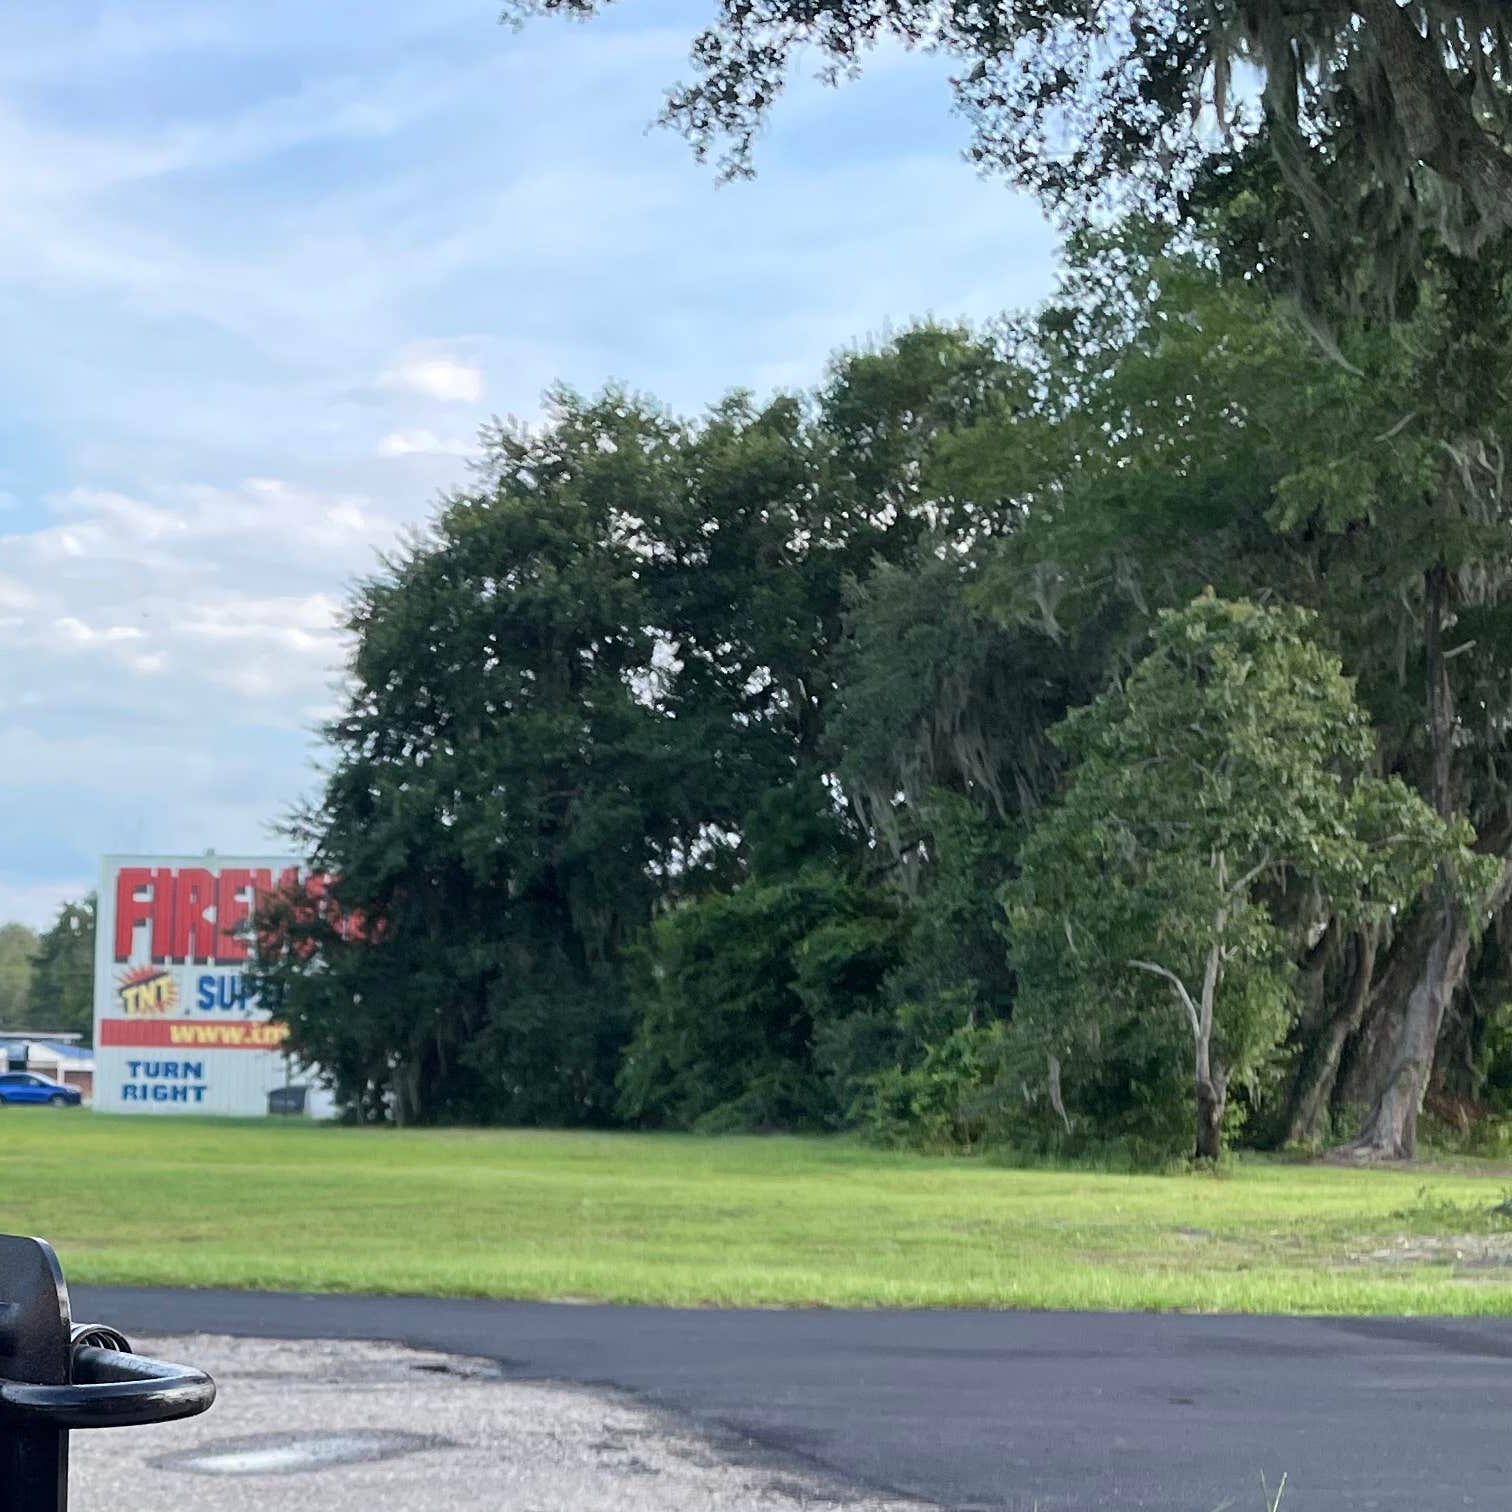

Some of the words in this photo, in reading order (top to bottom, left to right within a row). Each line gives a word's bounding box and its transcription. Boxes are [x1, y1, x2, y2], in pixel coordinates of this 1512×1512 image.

[121, 974, 173, 1015] TNT
[127, 1061, 202, 1079] TURN
[122, 1085, 207, 1103] RIGHT
